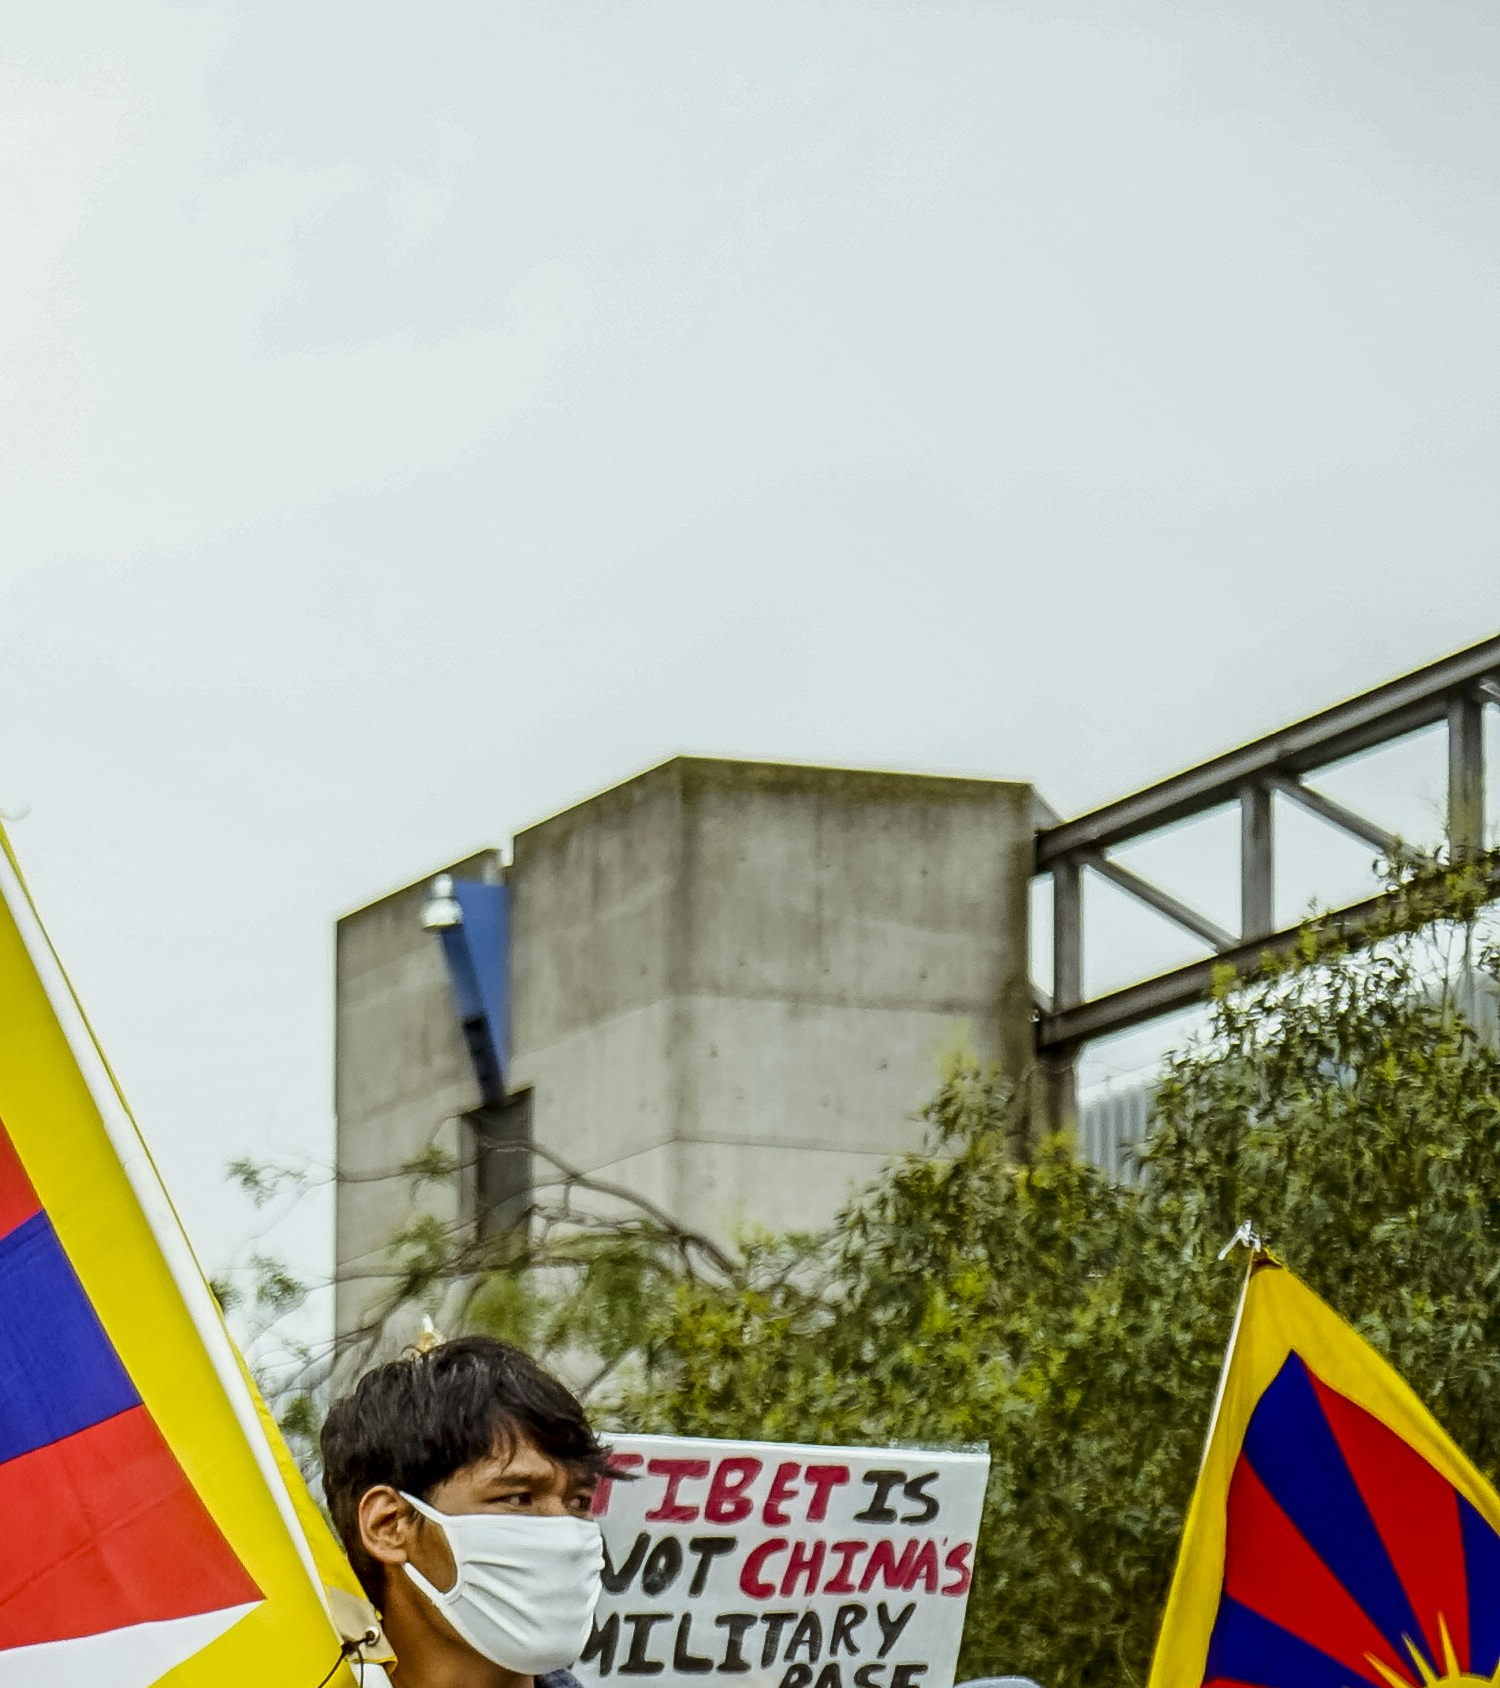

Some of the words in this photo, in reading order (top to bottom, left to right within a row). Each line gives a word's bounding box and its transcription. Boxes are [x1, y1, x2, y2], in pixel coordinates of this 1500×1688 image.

[592, 1453, 850, 1527] TIBET
[854, 1469, 940, 1526] IS
[601, 1532, 738, 1597] NOT
[740, 1536, 973, 1600] CHINA'S
[579, 1601, 916, 1679] MILITARY
